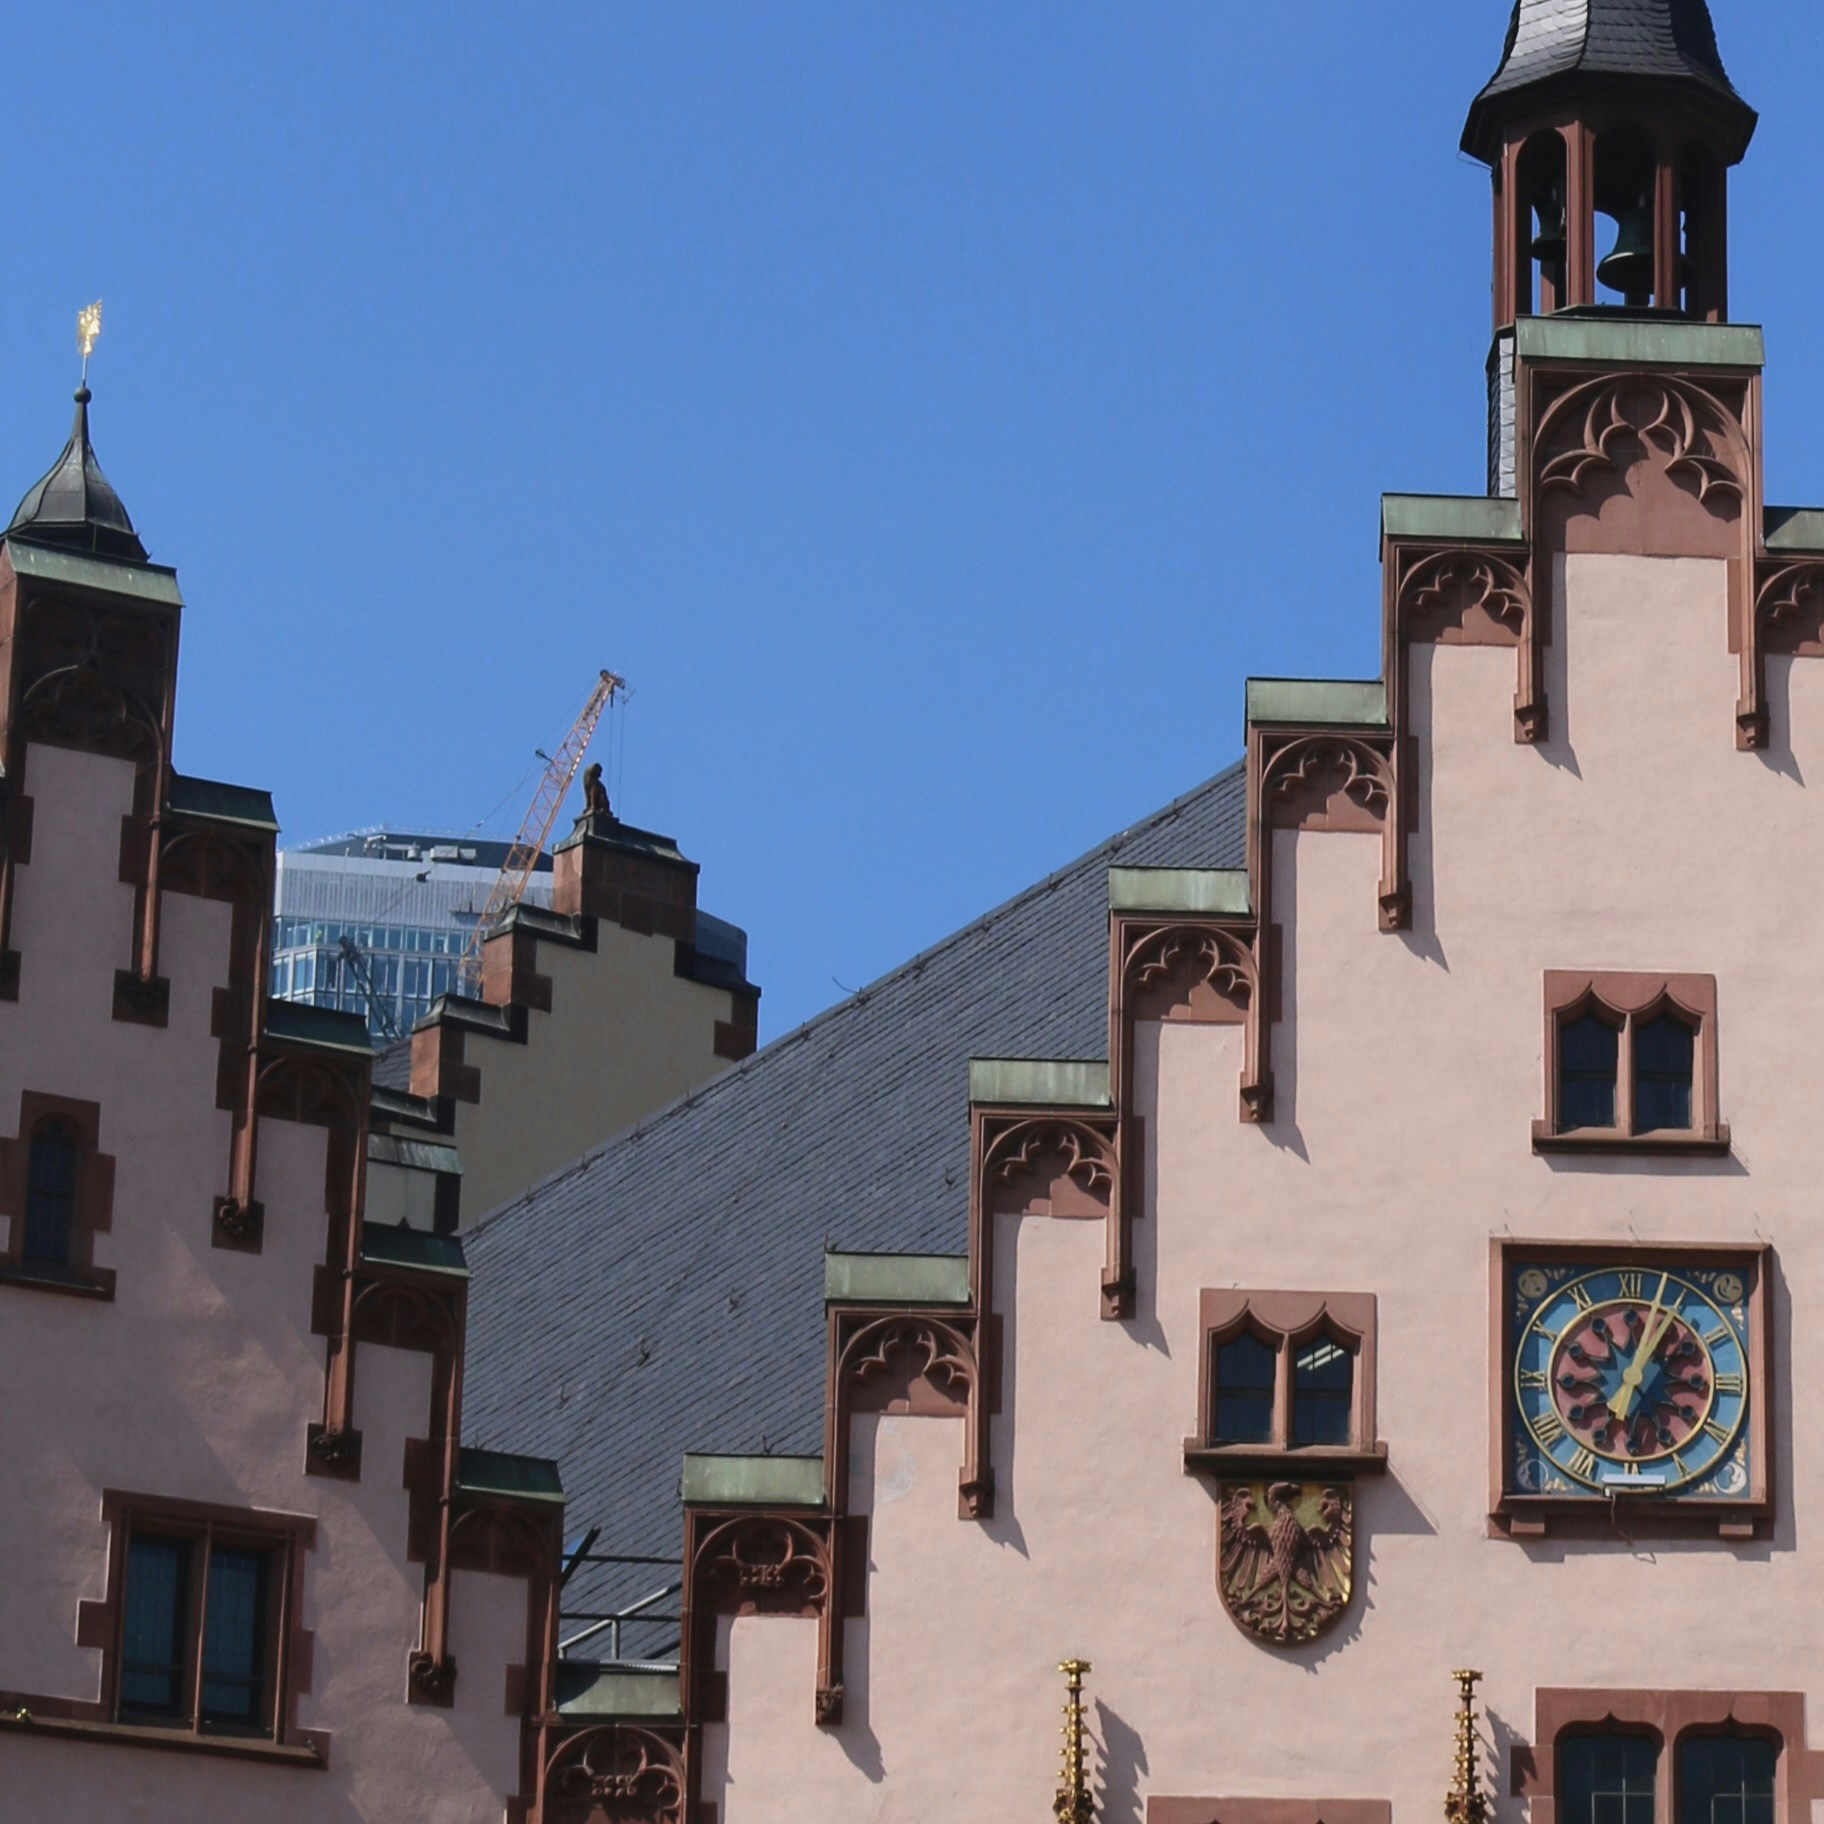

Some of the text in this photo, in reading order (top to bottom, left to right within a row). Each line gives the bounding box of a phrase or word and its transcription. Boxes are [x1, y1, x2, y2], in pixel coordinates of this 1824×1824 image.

[1566, 1282, 1594, 1312] XI
[1618, 1273, 1642, 1298] XII
[1532, 1319, 1558, 1342] X
[1703, 1325, 1729, 1344] II
[1520, 1368, 1546, 1388] IX
[1715, 1373, 1742, 1393] III
[1531, 1413, 1562, 1447] VIII
[1703, 1417, 1730, 1445] IV
[1567, 1447, 1595, 1480] VII
[1672, 1452, 1693, 1480] V
